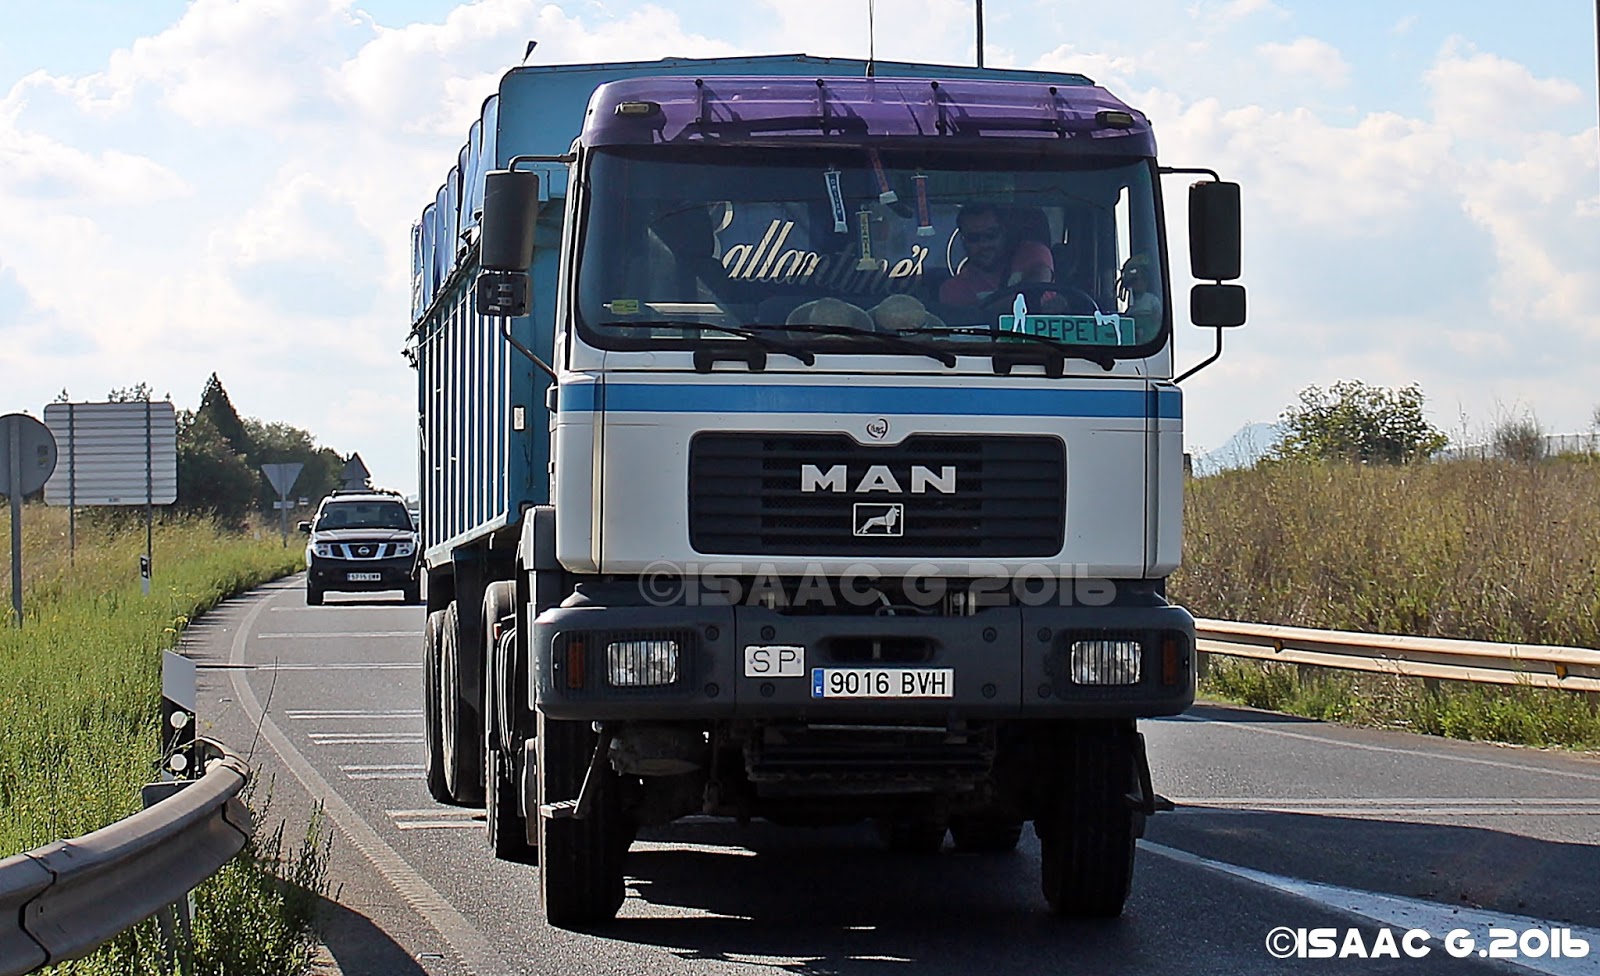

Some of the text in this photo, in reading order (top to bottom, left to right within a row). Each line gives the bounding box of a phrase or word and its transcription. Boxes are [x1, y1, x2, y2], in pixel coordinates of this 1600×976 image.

[801, 464, 957, 494] MAN
[830, 671, 890, 695] 9016
[901, 672, 946, 695] BVH
